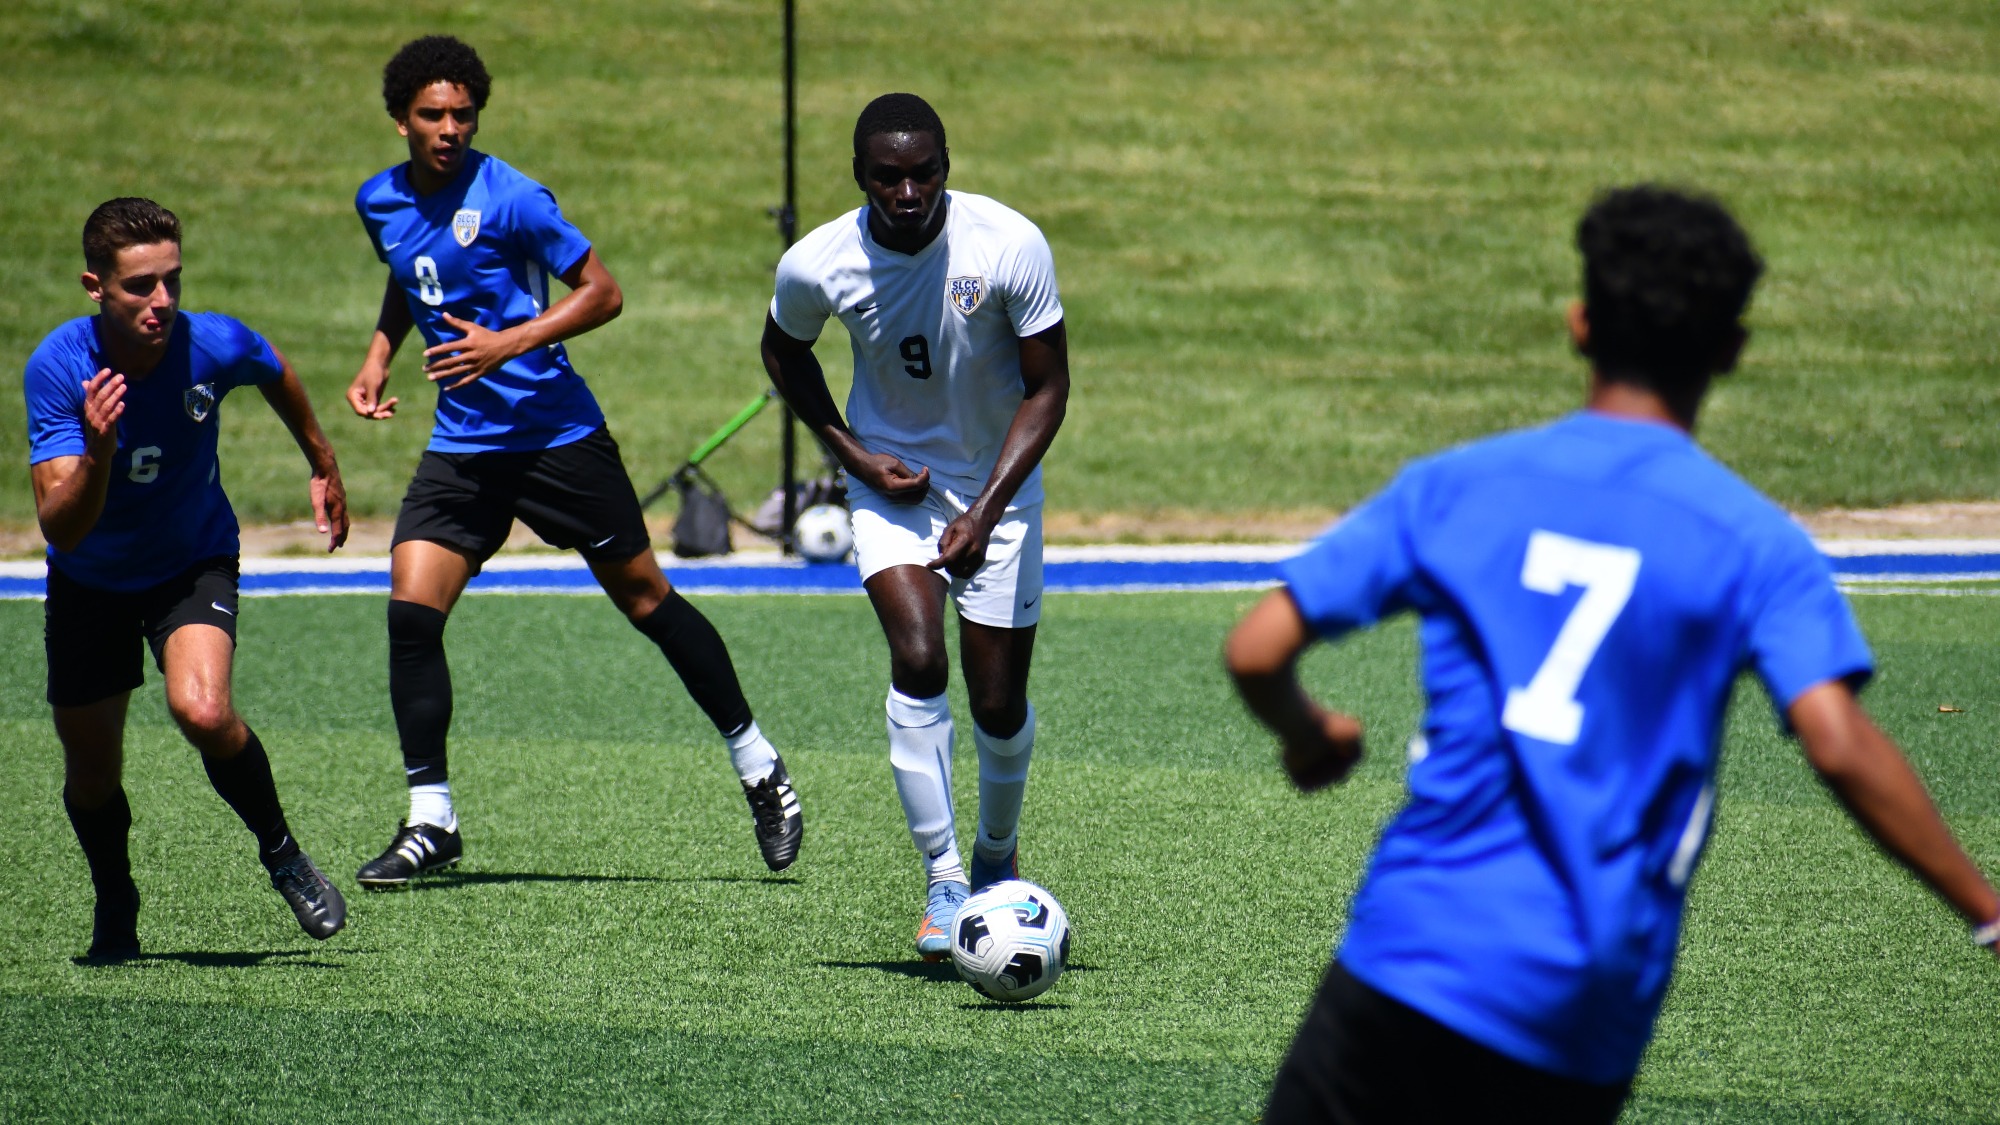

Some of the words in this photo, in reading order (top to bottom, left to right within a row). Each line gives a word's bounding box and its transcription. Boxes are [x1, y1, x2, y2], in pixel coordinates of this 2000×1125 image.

[457, 214, 476, 223] SLCC
[415, 255, 444, 306] 8
[952, 280, 978, 290] SLCC
[899, 335, 932, 379] 9
[128, 446, 161, 483] 6
[1502, 529, 1642, 745] 7
